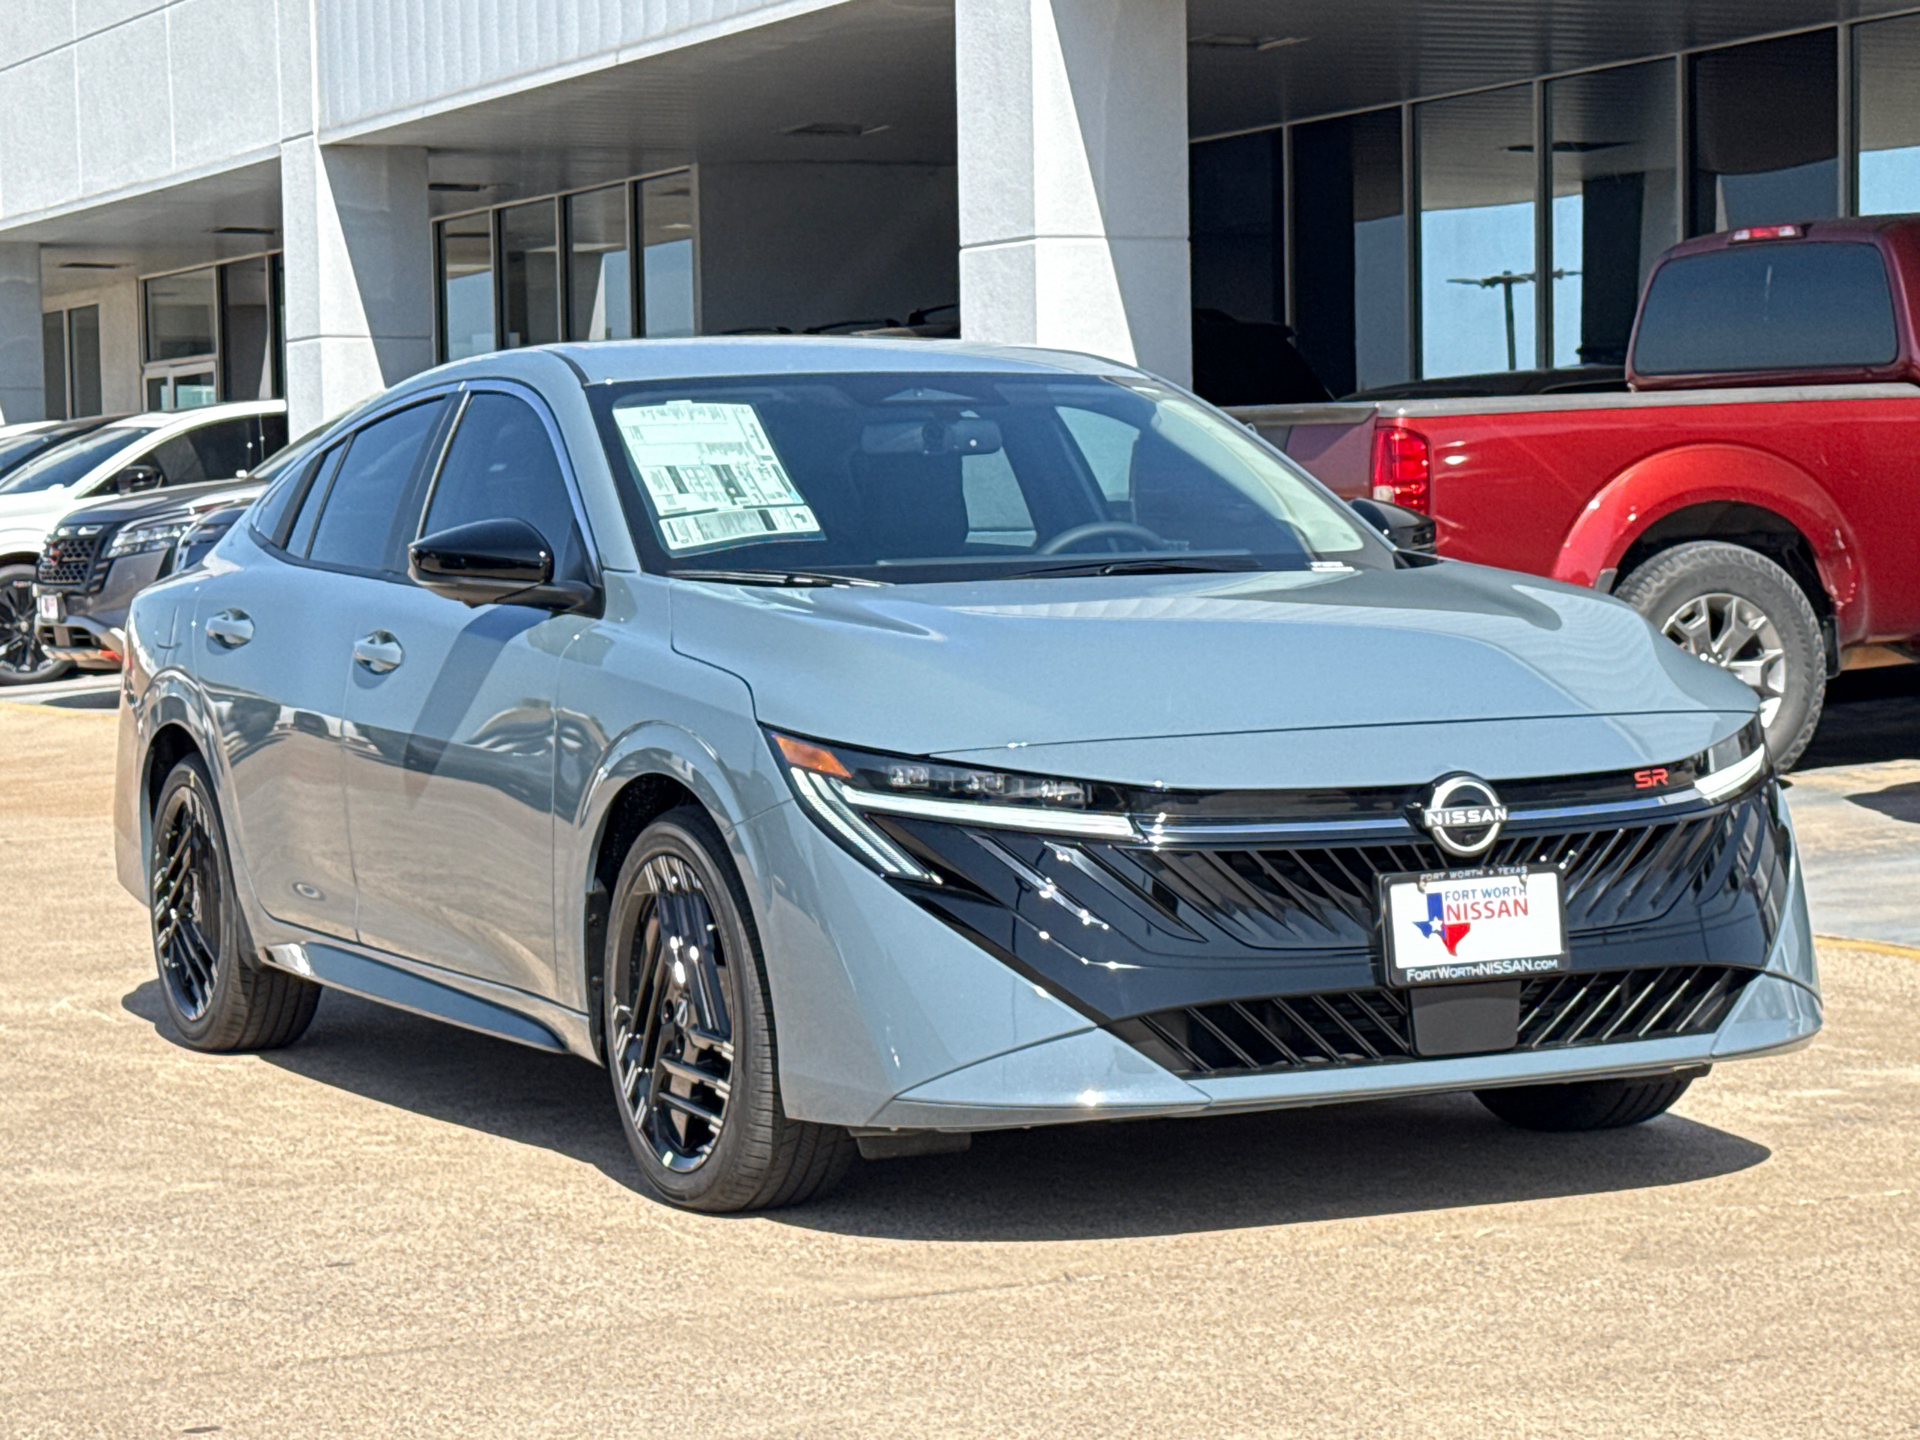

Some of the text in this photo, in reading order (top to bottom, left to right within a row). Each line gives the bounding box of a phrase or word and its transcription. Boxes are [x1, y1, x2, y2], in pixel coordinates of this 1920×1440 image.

[1634, 768, 1669, 788] SR
[1426, 808, 1507, 826] NISSAN
[1420, 866, 1528, 881] FORT WORTH TEXAS
[1444, 886, 1527, 901] FORT WORTH
[1446, 898, 1528, 921] NISSAN
